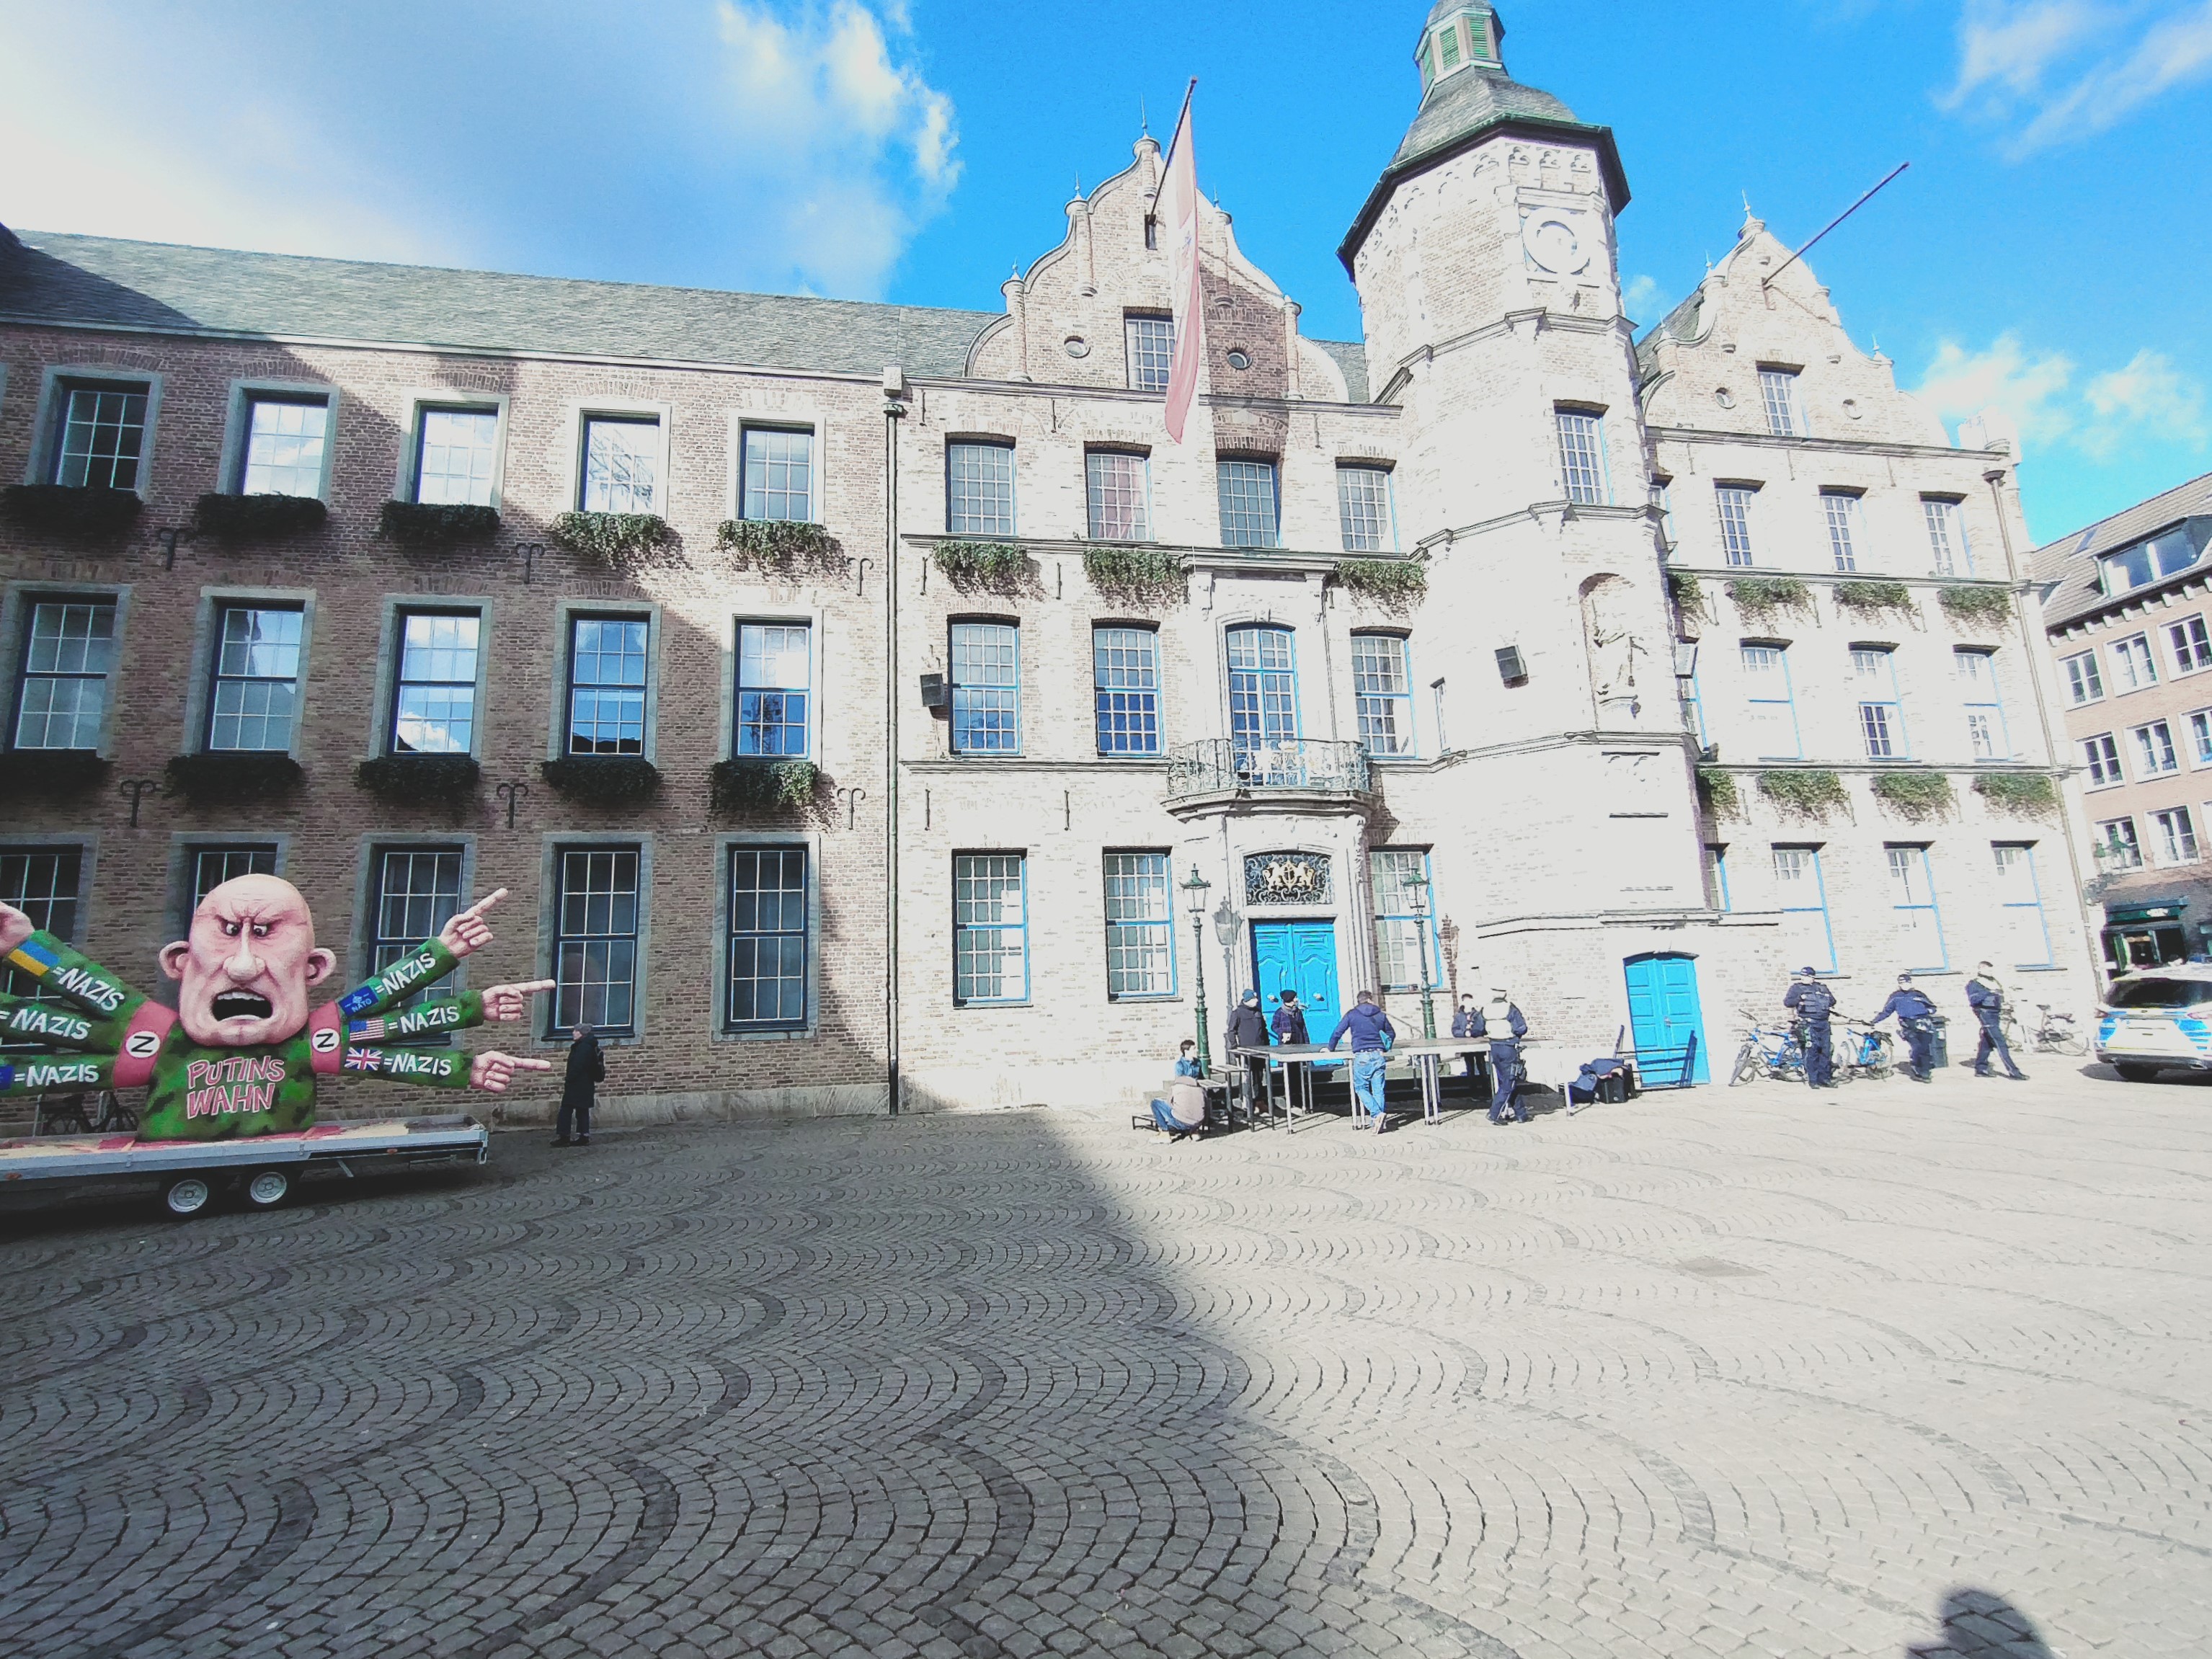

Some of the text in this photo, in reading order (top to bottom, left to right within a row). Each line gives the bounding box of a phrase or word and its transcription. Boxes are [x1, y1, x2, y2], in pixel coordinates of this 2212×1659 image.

[351, 998, 373, 1013] NATO
[130, 1035, 156, 1053] Z
[315, 1032, 334, 1049] Z
[187, 1055, 285, 1090] PUTINS
[187, 1082, 275, 1119] WAHN
